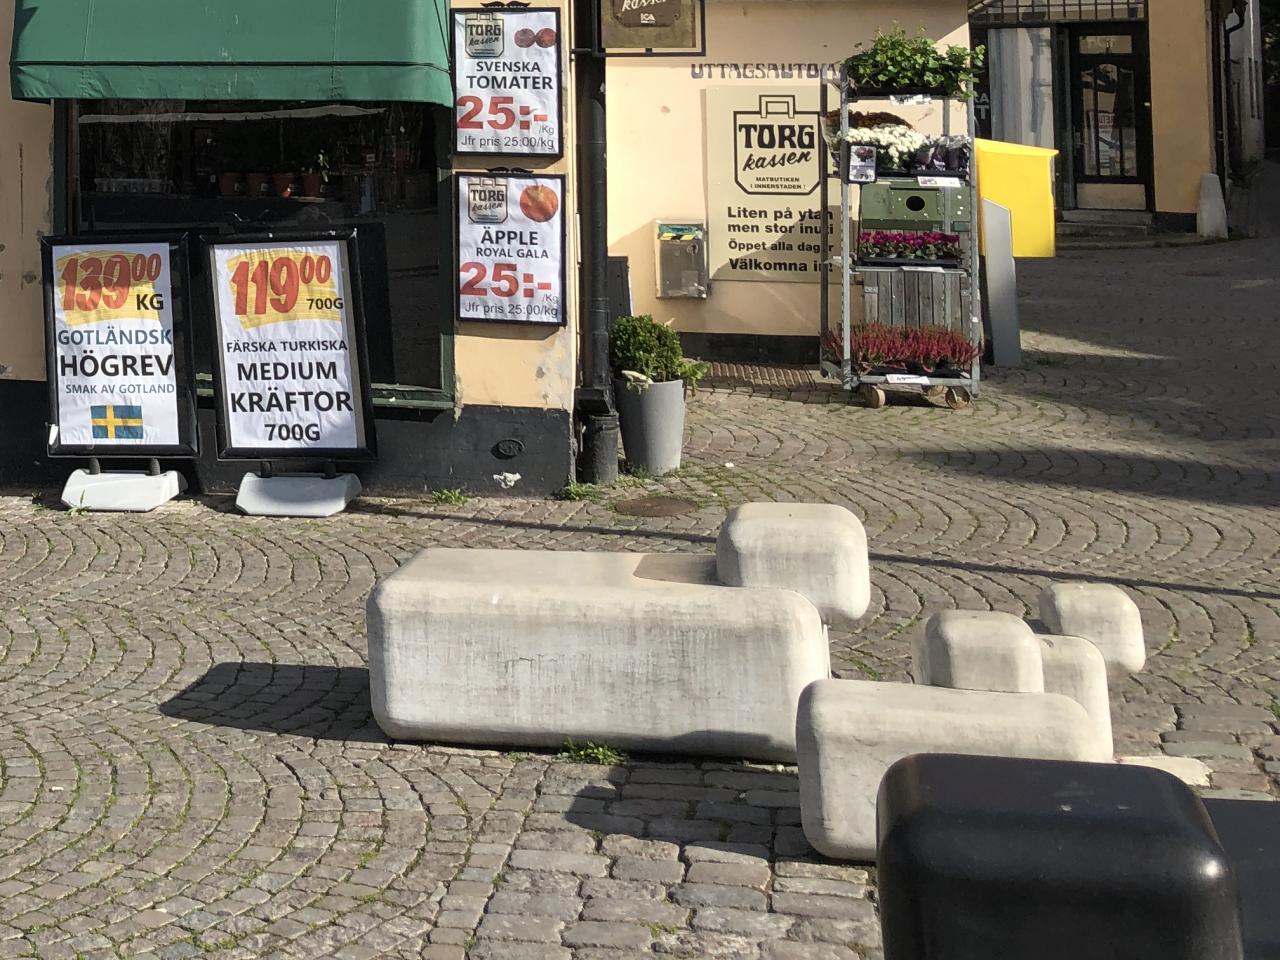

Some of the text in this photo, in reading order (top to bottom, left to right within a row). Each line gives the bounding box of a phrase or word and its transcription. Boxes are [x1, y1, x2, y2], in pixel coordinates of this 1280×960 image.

[640, 12, 656, 21] ICA
[467, 24, 502, 37] TORG
[476, 61, 541, 73] SVENSKA
[466, 75, 553, 90] TOMATER
[457, 95, 548, 130] 25:-
[539, 124, 554, 136] /Kg
[738, 124, 815, 149] TORG
[461, 136, 554, 150] Jfr pris 25:00/kg
[742, 150, 812, 171] kassen
[470, 189, 505, 202] TORG
[727, 206, 768, 218] Liten
[773, 206, 793, 221] på
[481, 226, 539, 246] ÄPPLE
[727, 223, 834, 234] men stor inui
[476, 247, 549, 259] ROYAL GALA
[728, 237, 835, 254] Öppet alla dagr
[729, 258, 833, 272] Välkomna i!
[460, 261, 552, 298] 25:-
[136, 293, 164, 311] KG
[306, 298, 344, 310] 700G
[464, 301, 558, 318] Jfr pris 25:00/kg
[58, 325, 172, 346] GOTLÄNDSK
[226, 339, 348, 352] FÄRSKA TURKISKA
[60, 350, 174, 377] HÖGREV
[237, 361, 337, 381] MEDIUM
[65, 383, 175, 394] SMAK AV GOTLAND
[230, 386, 354, 413] KRÄFTOR
[264, 423, 321, 442] 700G
